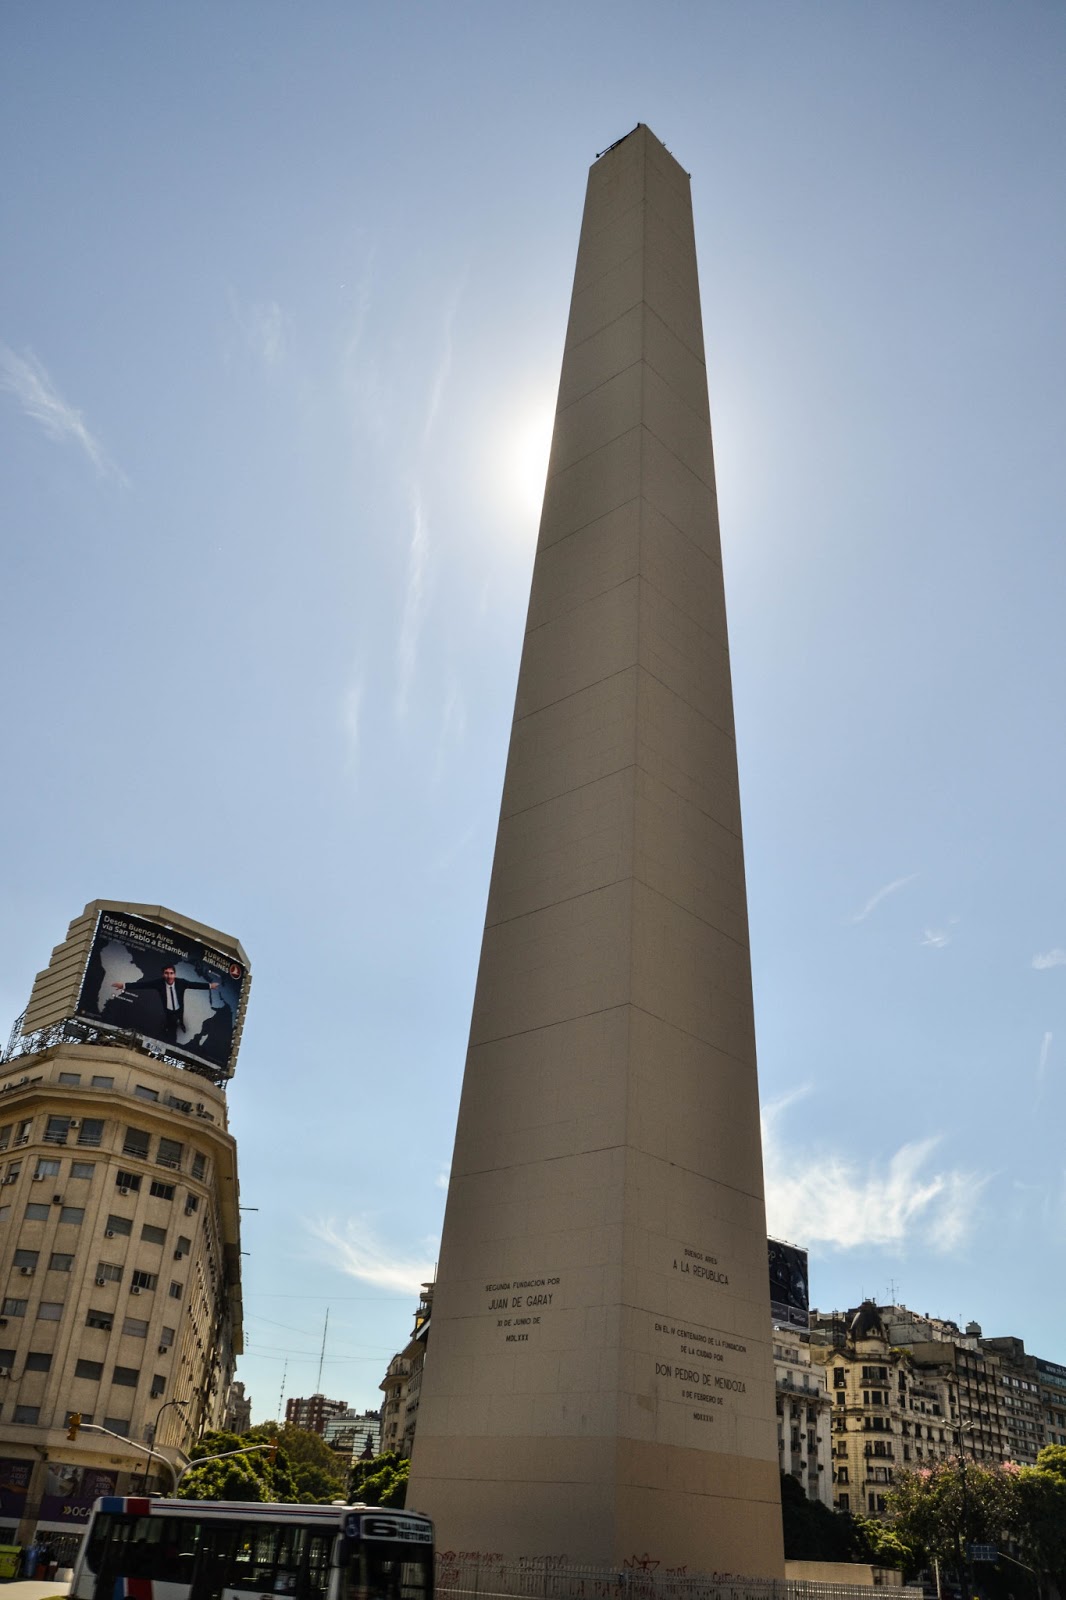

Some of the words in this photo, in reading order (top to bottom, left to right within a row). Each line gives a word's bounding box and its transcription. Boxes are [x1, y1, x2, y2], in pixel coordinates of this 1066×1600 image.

[104, 915, 127, 928] Desde
[128, 923, 155, 938] Buenos
[156, 933, 174, 945] Aires
[114, 926, 128, 936] San
[129, 931, 151, 943] Pablo
[157, 940, 188, 958] Estambul
[202, 956, 229, 974] AIRLINES
[204, 950, 230, 968] TURKISH
[684, 1248, 703, 1260] BUENOS
[673, 1259, 678, 1270] A
[680, 1260, 690, 1273] LA
[693, 1264, 729, 1285] REPUBLICA
[485, 1284, 510, 1292] SEGUNDA
[512, 1279, 545, 1289] FUNDACION
[547, 1277, 560, 1285] POR
[488, 1298, 508, 1310] JUAN
[512, 1296, 522, 1308] DE
[526, 1293, 553, 1307] GARAY
[504, 1319, 512, 1327] DE
[513, 1318, 531, 1326] JUNIO
[532, 1316, 541, 1324] DE
[505, 1333, 529, 1342] MDLXXX
[654, 1323, 662, 1331] EN
[663, 1325, 669, 1334] EL
[676, 1329, 707, 1343] CENTENARIO
[707, 1337, 714, 1346] DE
[715, 1339, 721, 1347] LA
[721, 1340, 747, 1353] FUNDACION
[680, 1345, 687, 1354] DE
[688, 1347, 695, 1355] LA
[696, 1349, 713, 1359] CIUDAD
[713, 1353, 724, 1362] POR
[655, 1362, 672, 1377] DON
[675, 1367, 700, 1383] PEDRO
[702, 1373, 711, 1386] DE
[714, 1376, 746, 1393] MENDOZA
[686, 1390, 693, 1399] DE
[693, 1392, 716, 1404] FEBRERO
[717, 1397, 723, 1405] DE
[72, 1506, 92, 1517] OCA
[364, 1518, 398, 1538] 6
[398, 1531, 431, 1542] RETIRO
